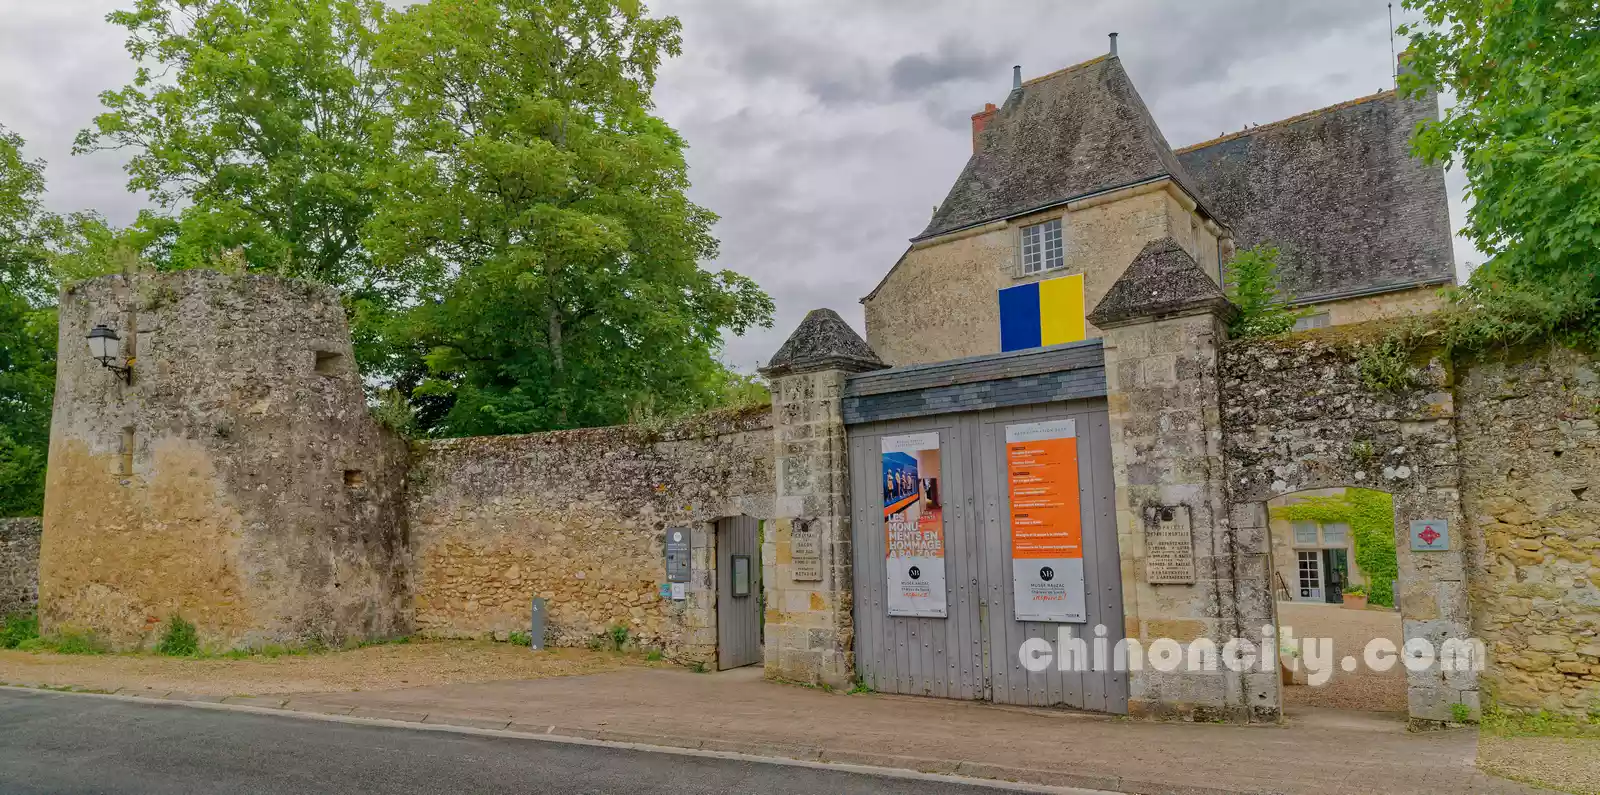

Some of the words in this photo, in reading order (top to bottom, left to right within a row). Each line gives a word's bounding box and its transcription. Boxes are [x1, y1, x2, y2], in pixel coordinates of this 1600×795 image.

[888, 513, 905, 522] LES
[888, 522, 922, 531] MONU-
[888, 531, 922, 541] MENTS
[924, 531, 938, 540] EN
[889, 541, 941, 550] HOMMAGE
[899, 550, 937, 558] BALZAC
